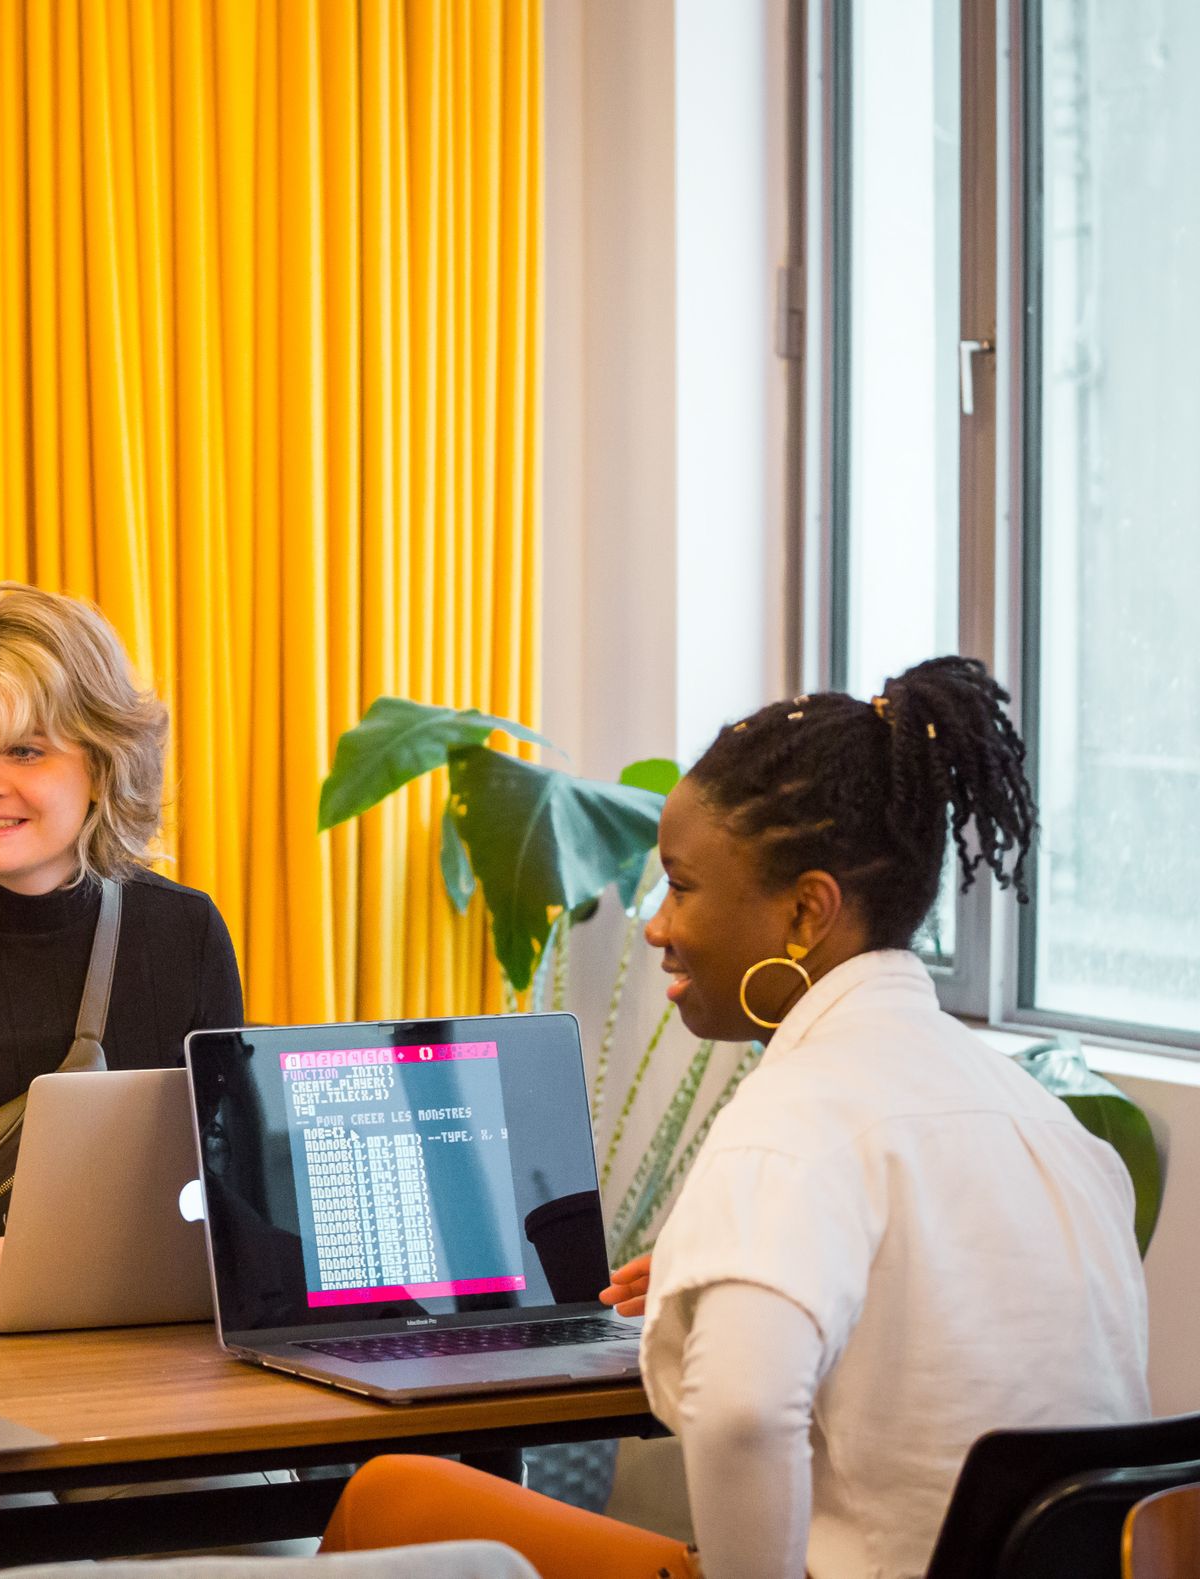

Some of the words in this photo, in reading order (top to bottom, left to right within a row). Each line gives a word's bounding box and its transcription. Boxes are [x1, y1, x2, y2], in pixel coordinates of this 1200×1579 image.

[282, 1068, 339, 1082] FUNCTION
[316, 1114, 344, 1127] POUR
[350, 1112, 385, 1125] CREER
[391, 1110, 412, 1123] LES
[418, 1107, 472, 1121] MONSTRES
[500, 1128, 508, 1139] Y
